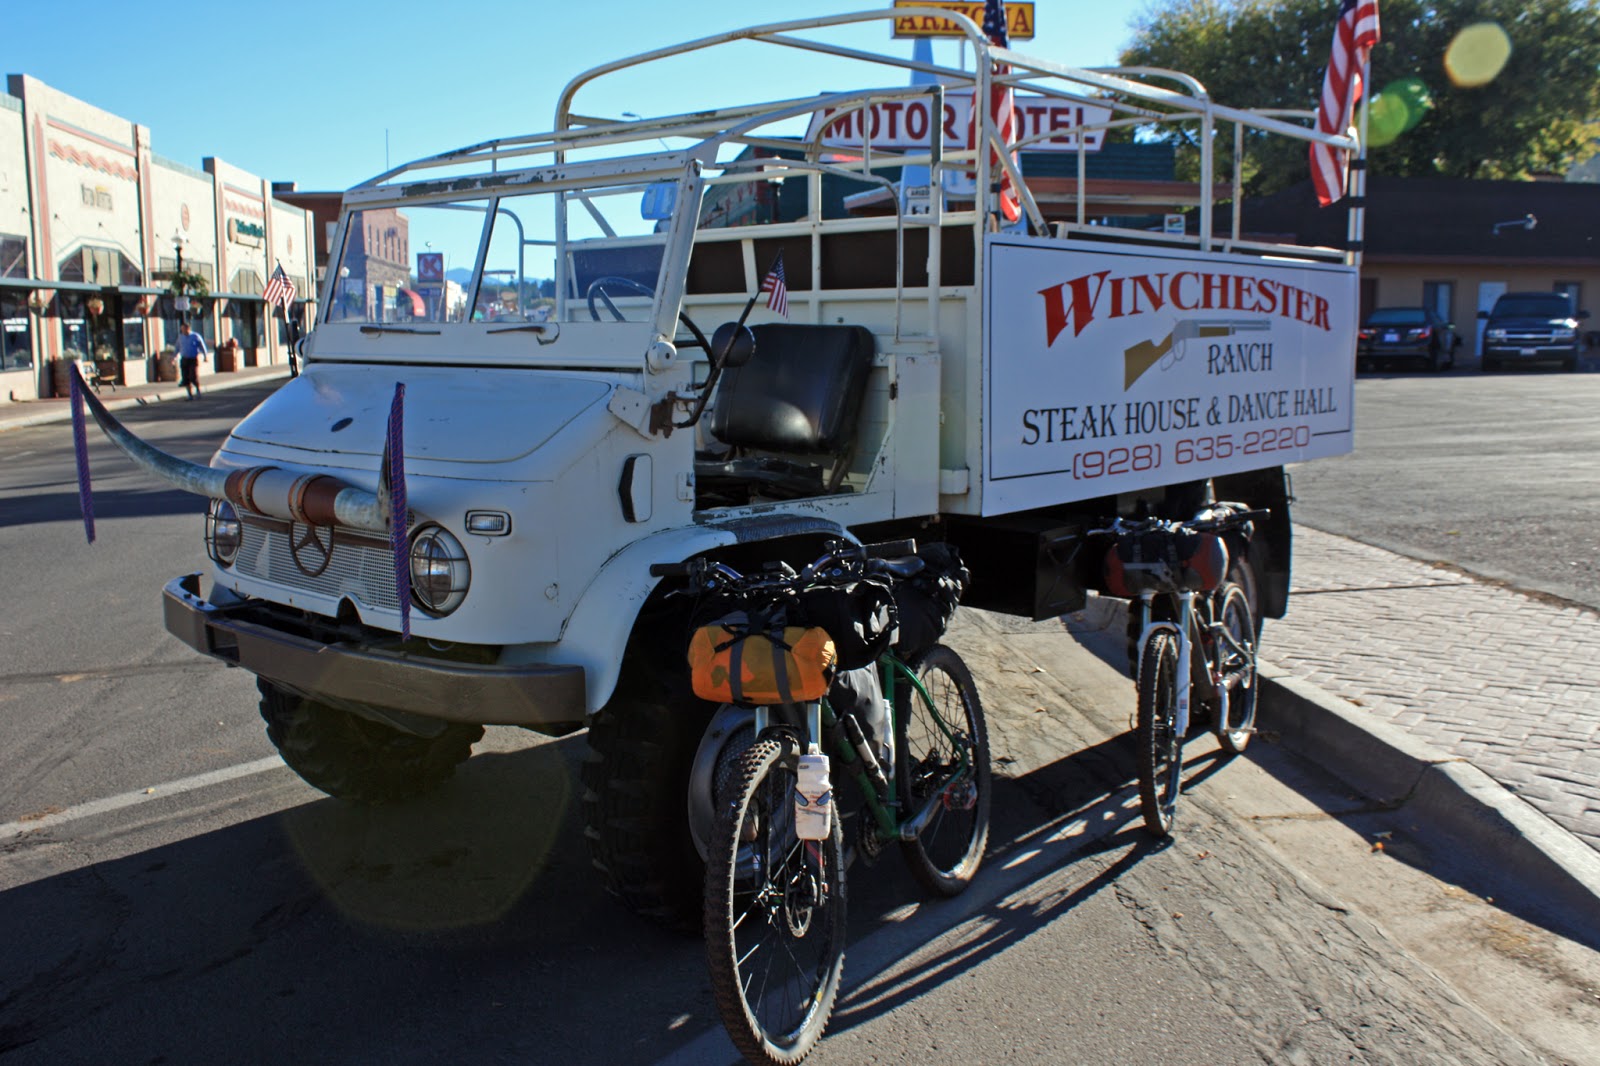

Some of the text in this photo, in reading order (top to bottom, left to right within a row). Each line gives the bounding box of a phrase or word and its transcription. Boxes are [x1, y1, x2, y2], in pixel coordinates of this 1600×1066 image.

[899, 5, 1031, 32] ARIZA
[825, 102, 1096, 144] MOTOR OTEL
[1037, 270, 1331, 348] WINCHESTER
[1208, 343, 1273, 375] RANCH
[1021, 387, 1337, 446] STEAK HOUSE & DANCE HALL
[1073, 425, 1310, 480] (928) 635-2220
